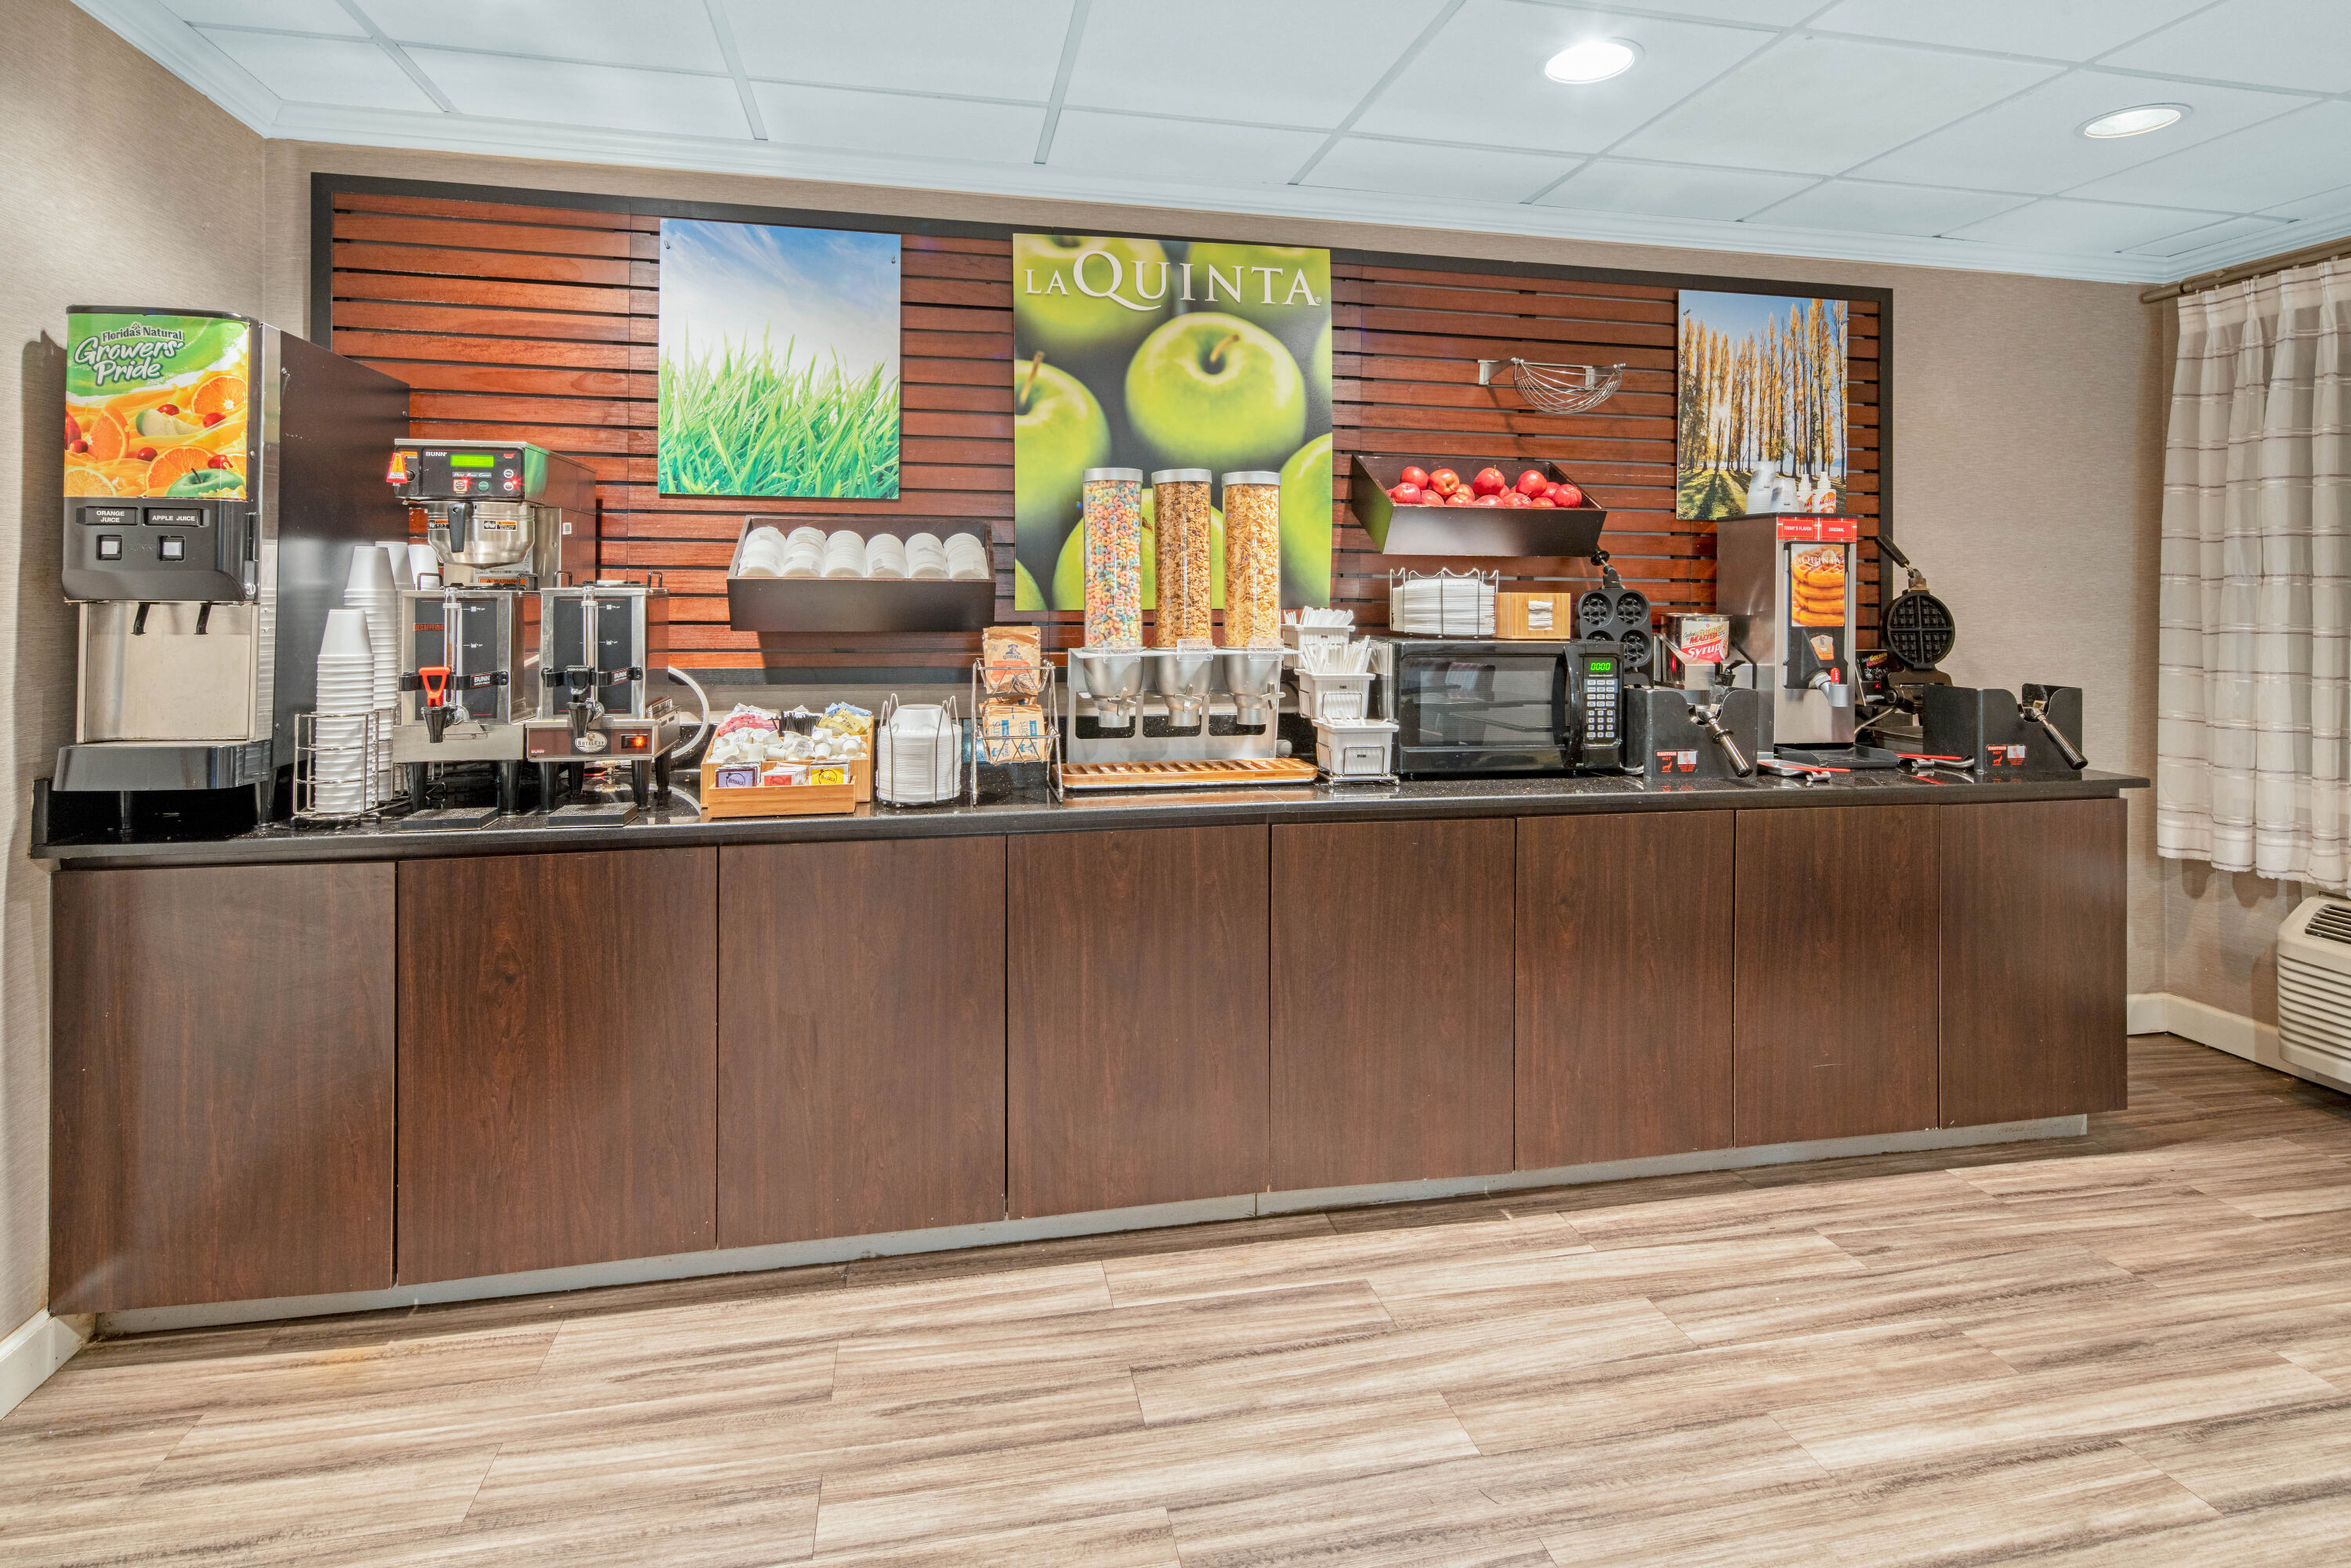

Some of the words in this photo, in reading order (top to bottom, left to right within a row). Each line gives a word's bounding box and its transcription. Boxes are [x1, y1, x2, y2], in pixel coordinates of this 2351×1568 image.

[1024, 269, 1070, 295] LA
[1073, 250, 1320, 311] QUINTA
[143, 326, 183, 340] Natural
[93, 357, 163, 386] Pride
[1802, 555, 1841, 567] QUINTA
[1690, 632, 1718, 643] MALTED
[1688, 643, 1721, 658] Syrup
